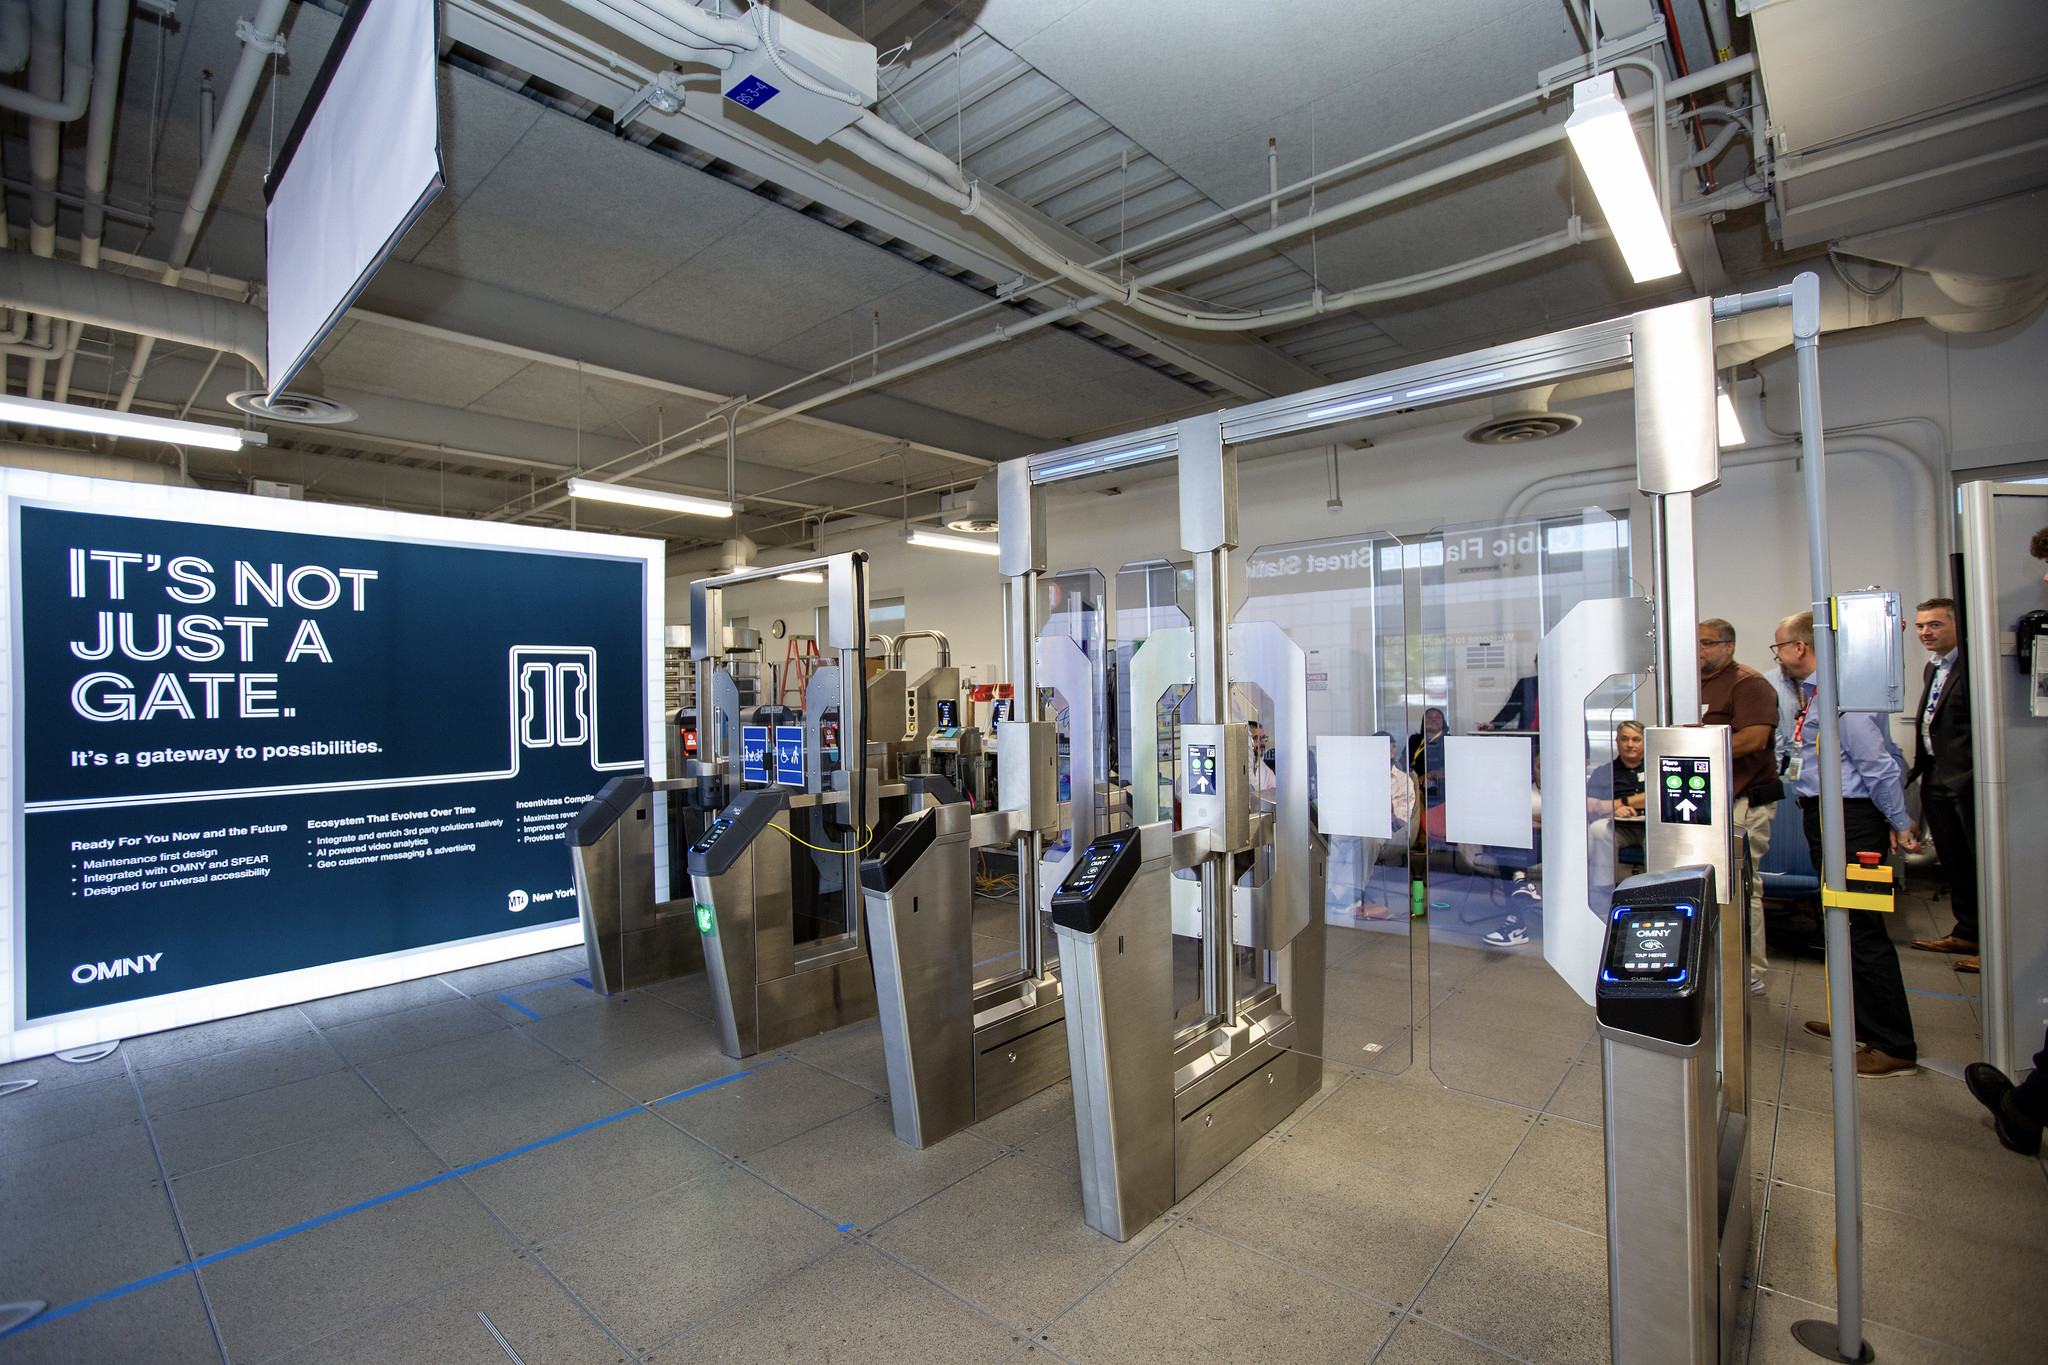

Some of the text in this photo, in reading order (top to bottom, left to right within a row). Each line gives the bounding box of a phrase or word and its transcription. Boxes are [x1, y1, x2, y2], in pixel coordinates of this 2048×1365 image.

[736, 82, 768, 105] BS 3-4
[70, 548, 378, 611] IT'S NOT
[70, 611, 333, 663] JUST A
[71, 671, 296, 722] GATE.
[71, 740, 383, 767] It's a gateway to possibilities.
[1670, 778, 1701, 787] 4 5
[516, 797, 562, 809] Incentivizes
[307, 806, 476, 829] Ecosystem That Evolves Over Time
[523, 813, 559, 823] Maximizes
[523, 823, 555, 833] Improves
[71, 824, 288, 851] Ready For You Now and the Future
[317, 818, 504, 845] Integrate and enrich 3rd party solutions natively
[524, 833, 554, 843] Provides
[83, 848, 218, 870] Maintenance first design
[316, 837, 429, 858] AI powered video analytics
[317, 843, 476, 869] Geo customer messaging & advertising
[84, 855, 269, 883] Integrated with OMNY and SPEAR
[84, 866, 271, 897] Designed for universal accessibility
[532, 887, 576, 903] New York
[1636, 929, 1671, 937] OMNY
[71, 952, 163, 983] OMNY
